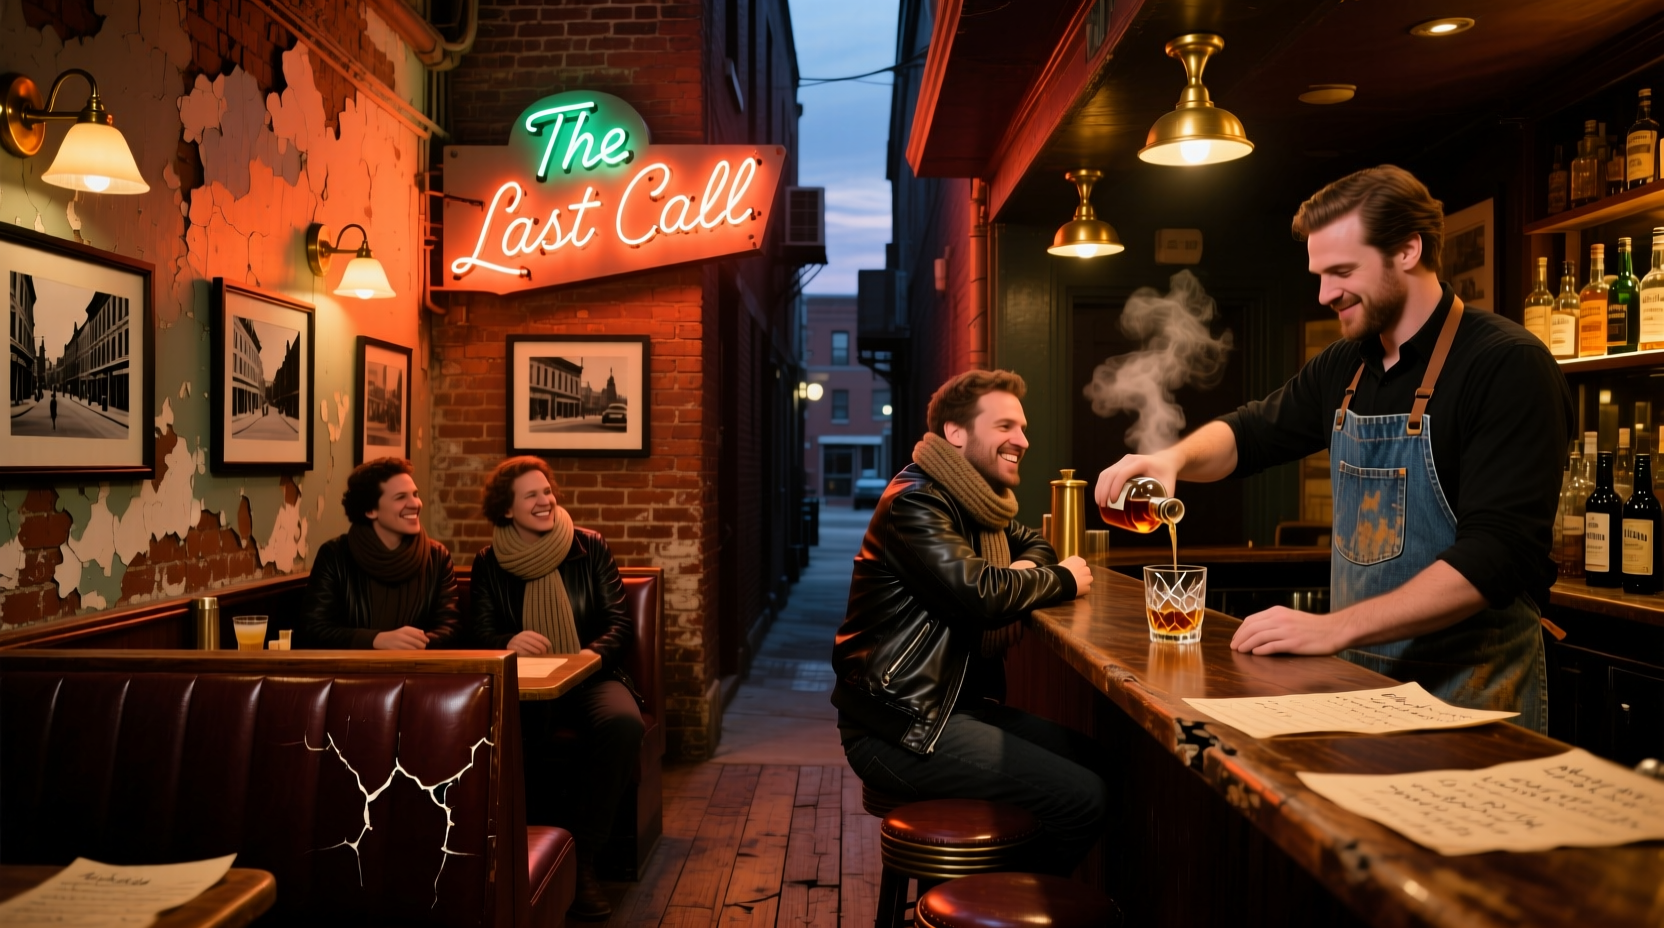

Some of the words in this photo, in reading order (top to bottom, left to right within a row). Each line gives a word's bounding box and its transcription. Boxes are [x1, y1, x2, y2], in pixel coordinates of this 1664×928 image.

[525, 101, 632, 178] The
[451, 181, 601, 276] Last
[615, 157, 756, 246] Call
